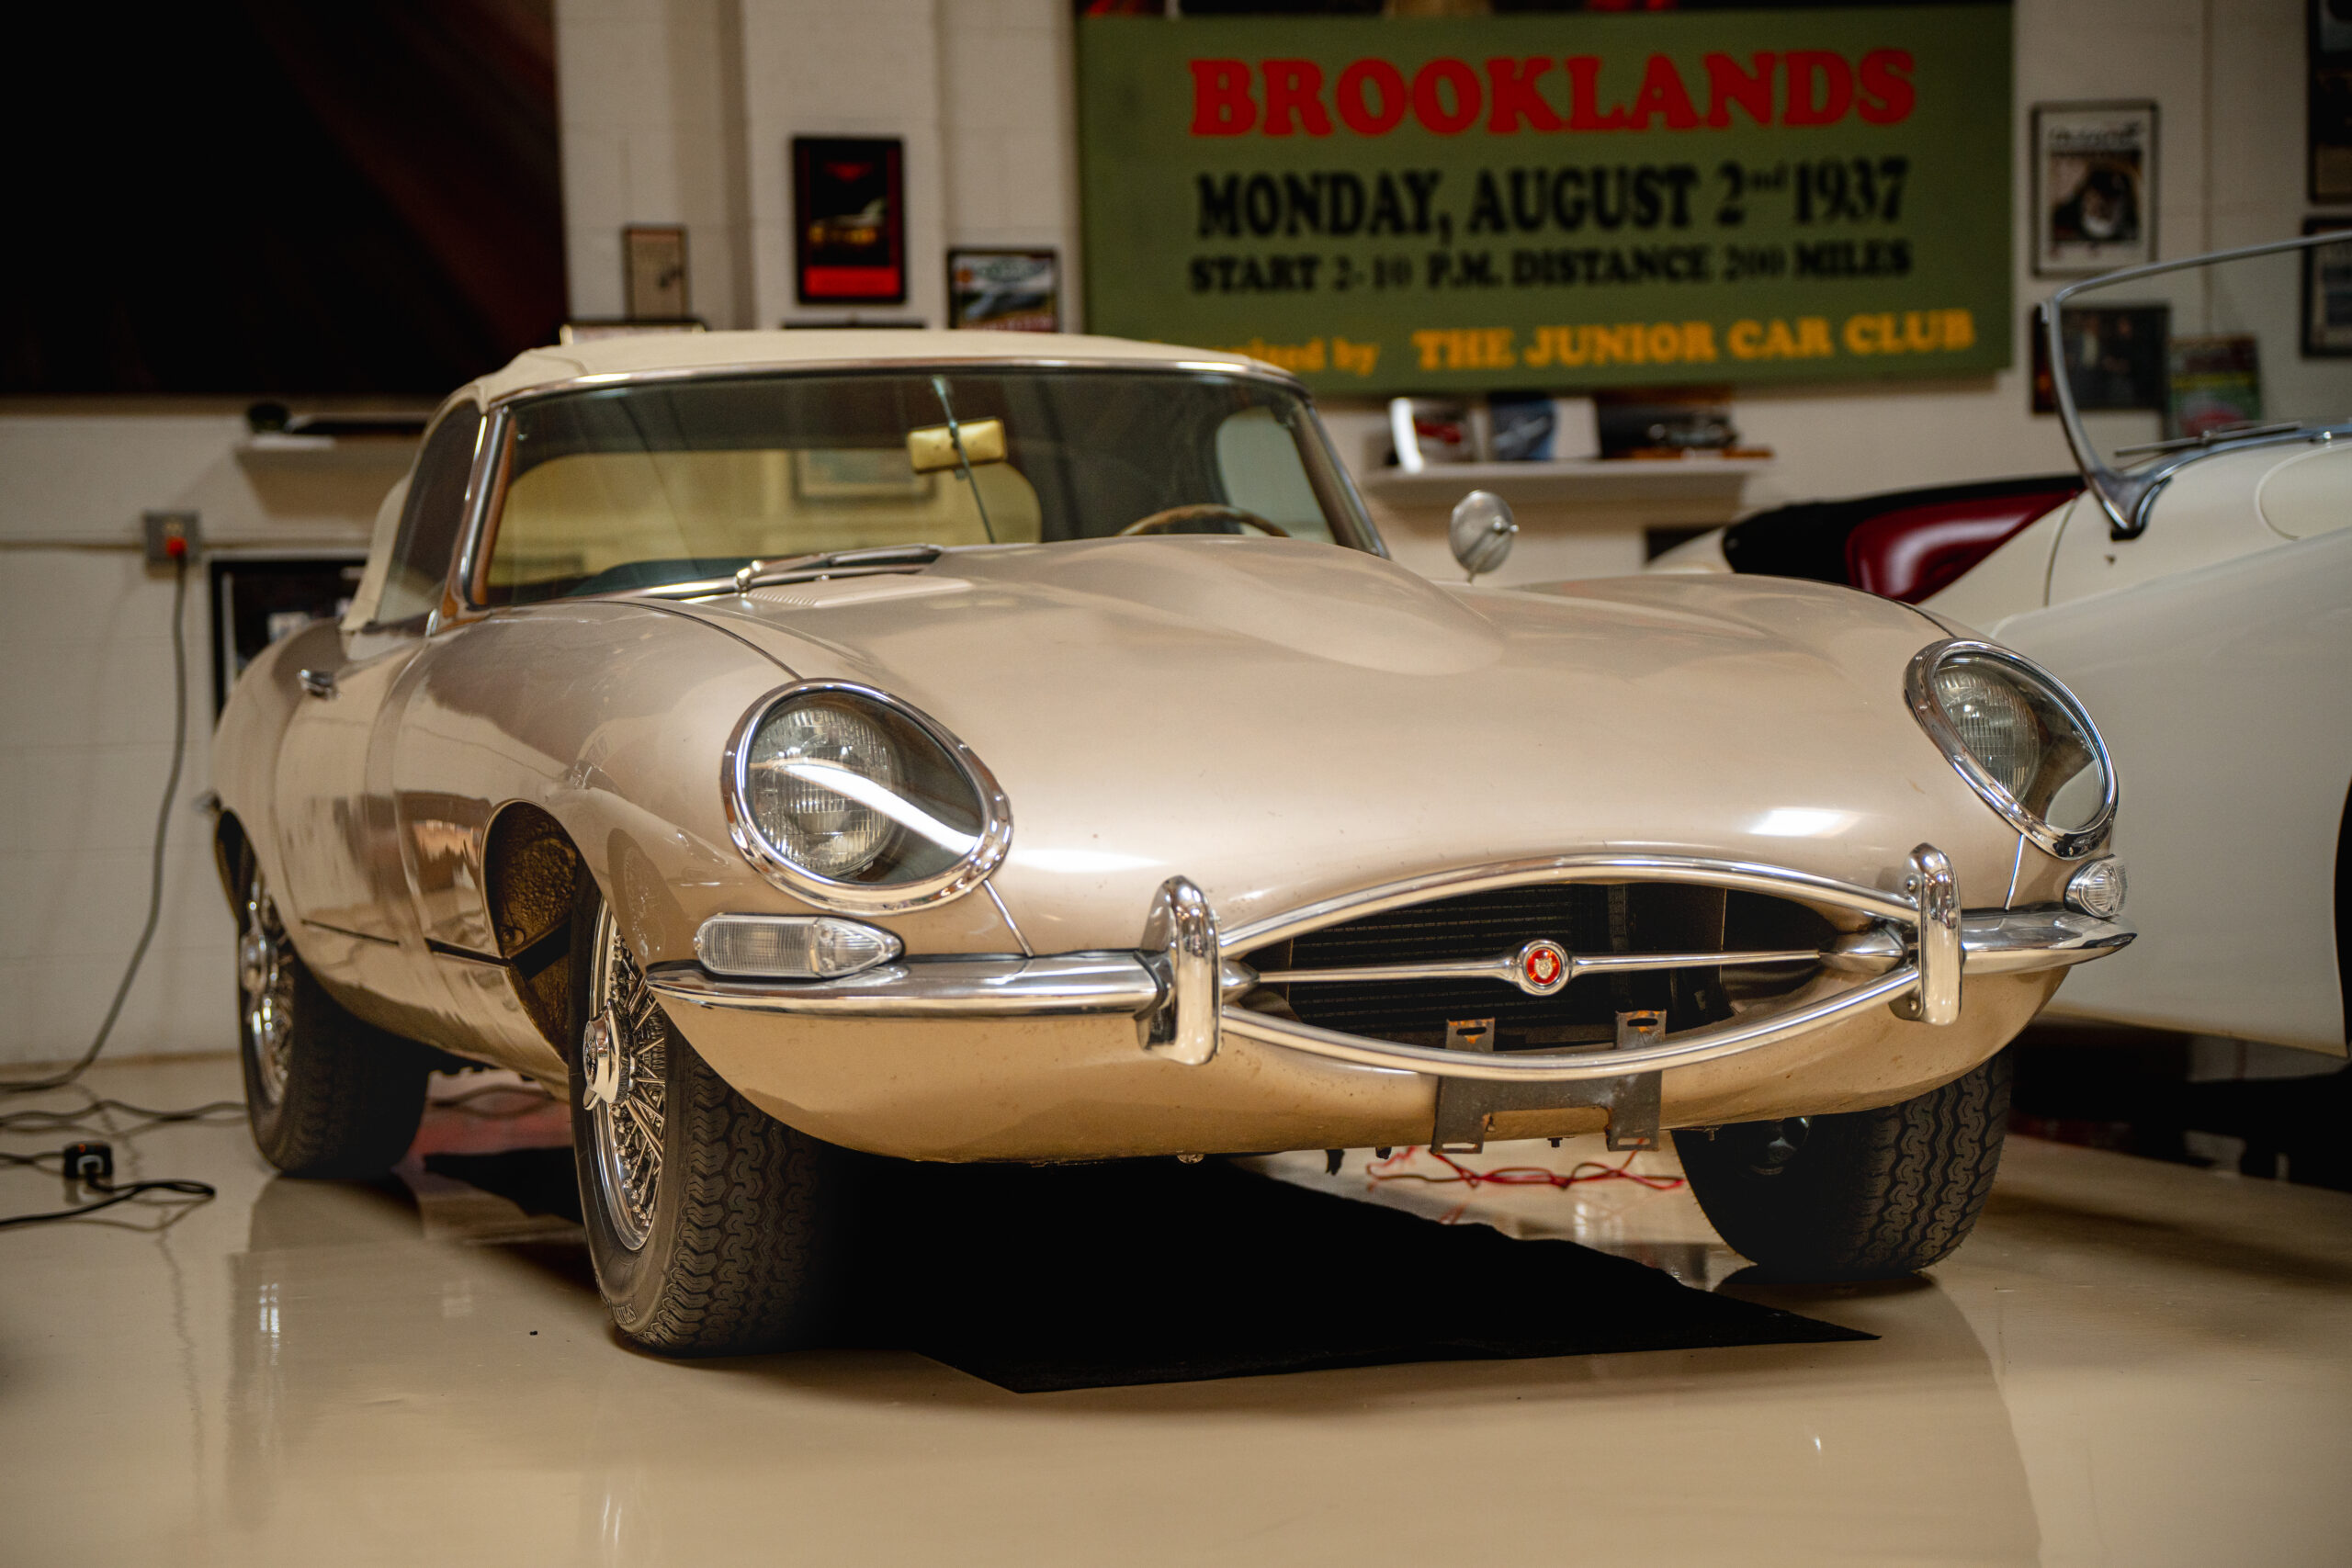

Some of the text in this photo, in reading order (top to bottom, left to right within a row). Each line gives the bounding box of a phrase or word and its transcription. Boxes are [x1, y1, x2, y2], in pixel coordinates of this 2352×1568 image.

[1188, 49, 1916, 138] BROOKLANDS
[1197, 154, 1912, 244] MONDAY, AUGUST 2nd 1937
[1190, 254, 1320, 293] START
[1512, 244, 1710, 288] DISTANCE
[1724, 246, 1786, 281] 200
[1794, 239, 1913, 278] MILES
[1332, 337, 1378, 376] by
[1411, 328, 1517, 370] THE
[1524, 321, 1717, 367] JUNIOR
[1727, 317, 1834, 359] CAR
[1844, 310, 1975, 355] CLUB
